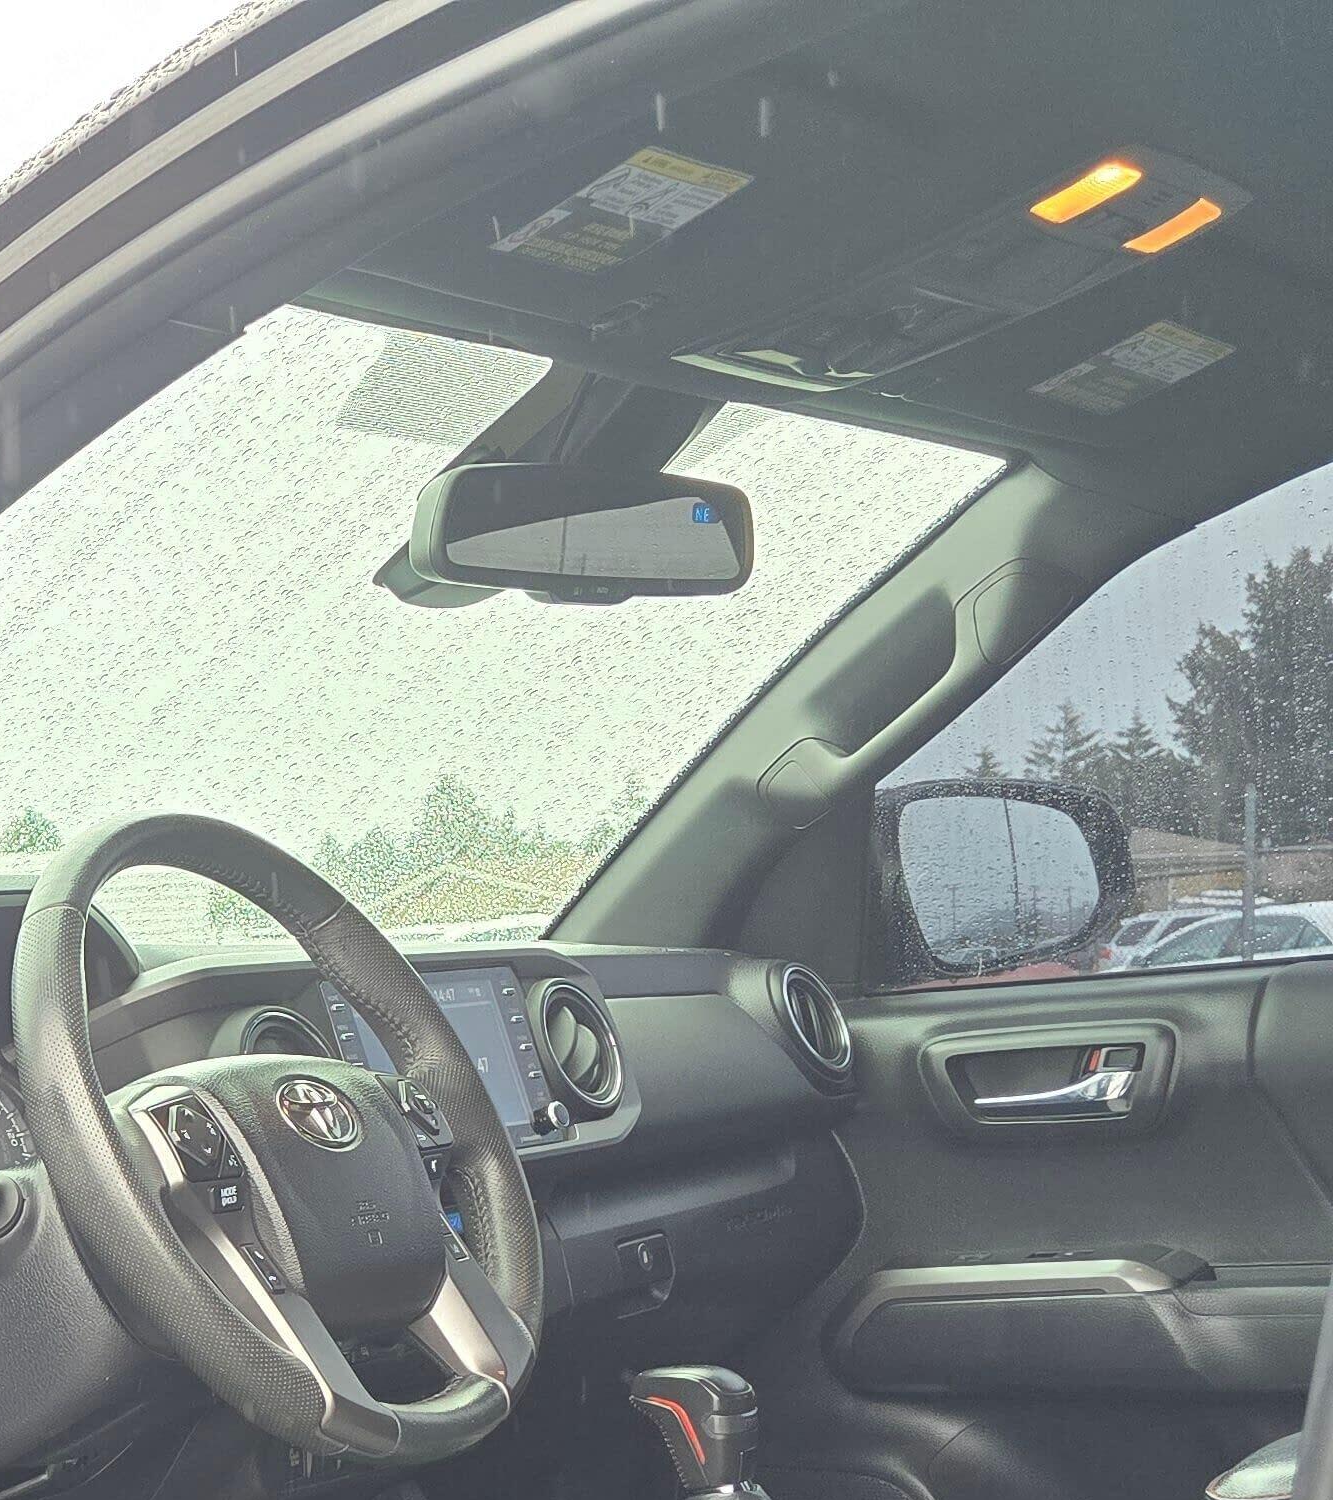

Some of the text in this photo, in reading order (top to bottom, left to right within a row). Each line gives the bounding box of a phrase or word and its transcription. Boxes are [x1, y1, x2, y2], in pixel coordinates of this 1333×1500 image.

[695, 508, 710, 522] NE
[6, 1129, 18, 1146] 120
[221, 1186, 237, 1198] MODE
